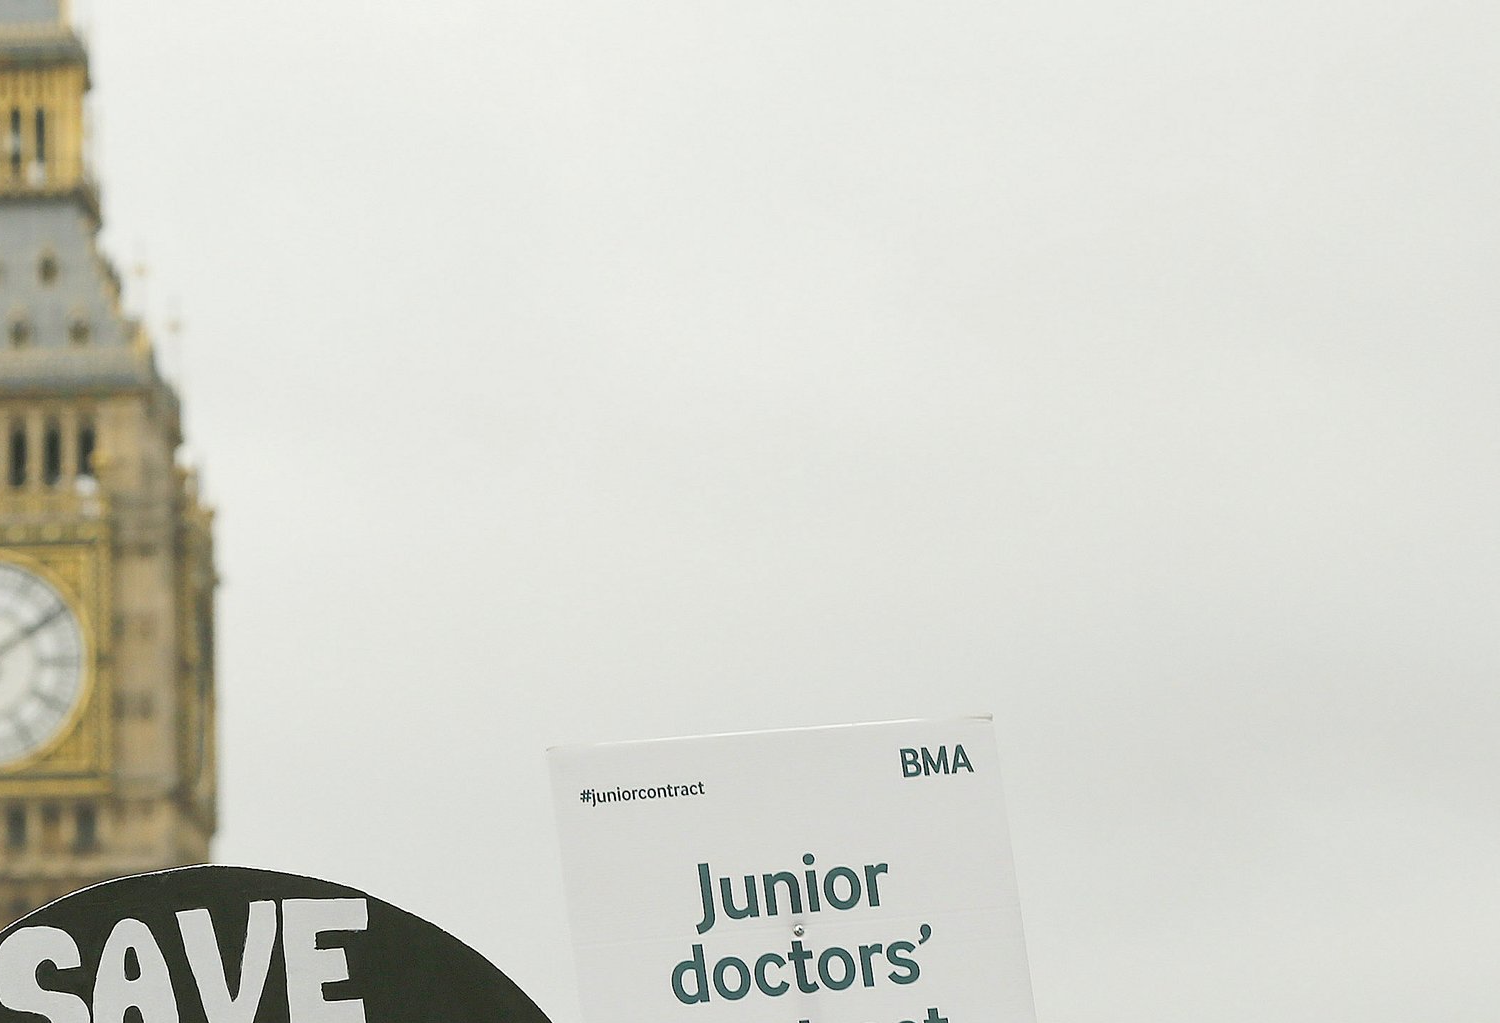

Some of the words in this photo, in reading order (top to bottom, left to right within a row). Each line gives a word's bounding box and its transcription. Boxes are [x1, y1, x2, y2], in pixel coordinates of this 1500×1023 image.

[900, 744, 975, 778] BMA
[579, 781, 706, 808] #juniorcontract
[695, 853, 889, 935] Junior
[671, 924, 933, 1006] doctors'
